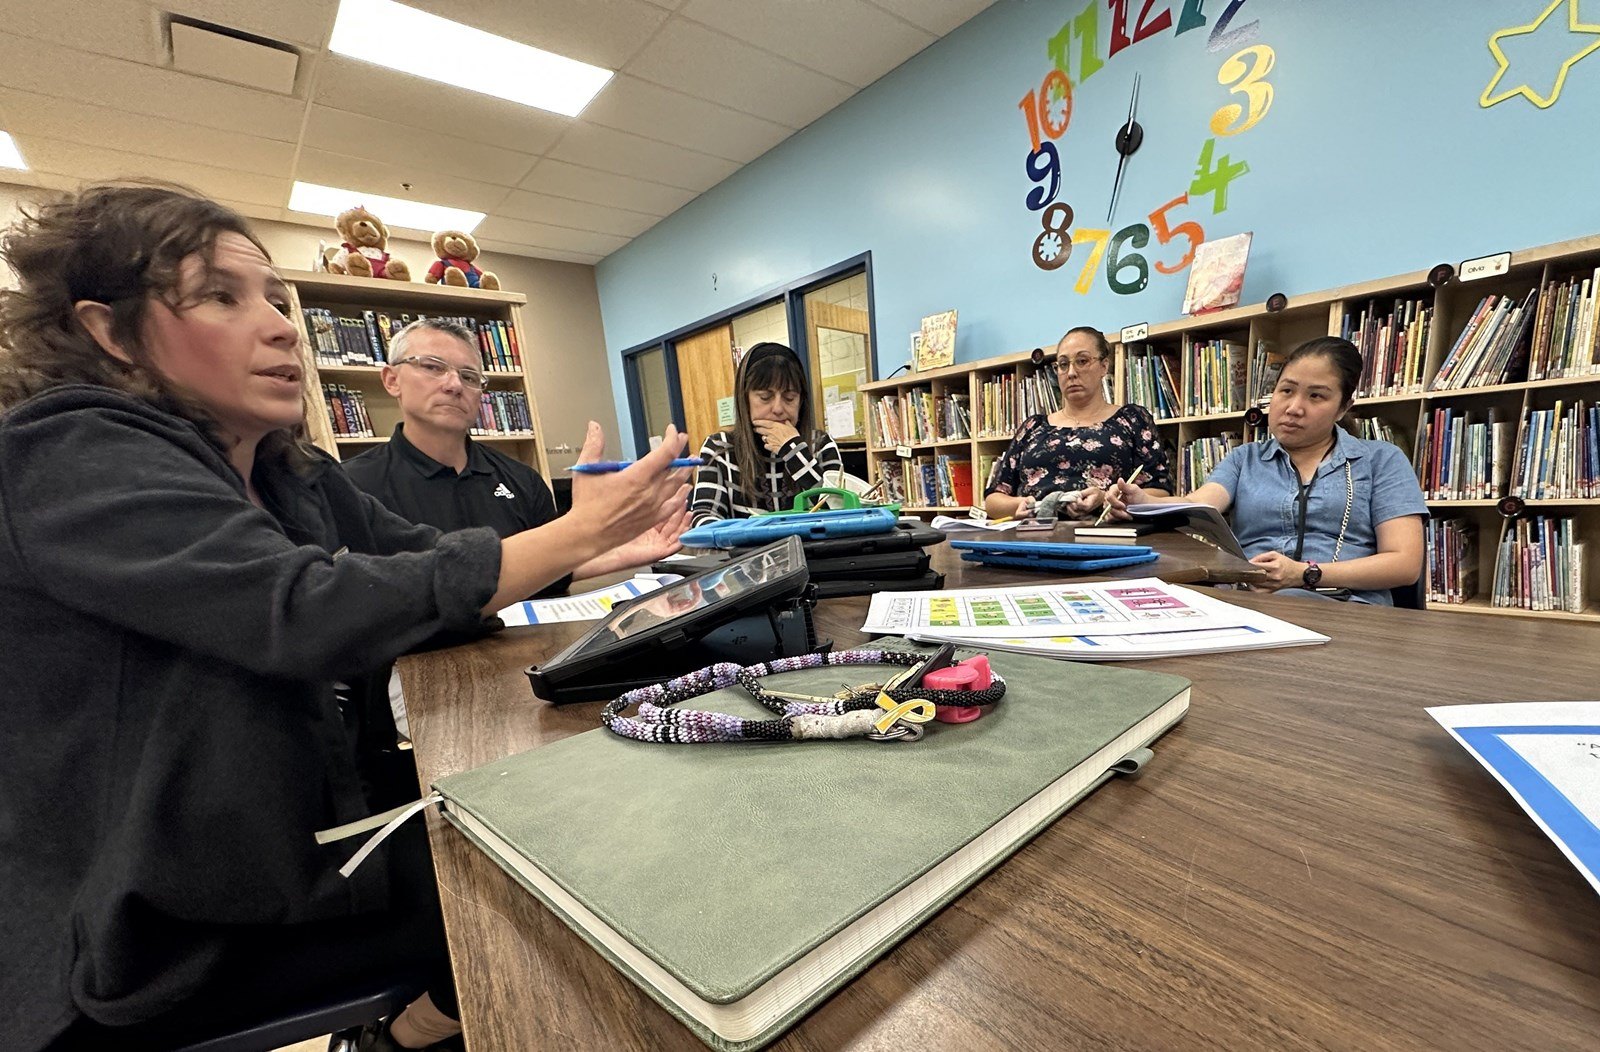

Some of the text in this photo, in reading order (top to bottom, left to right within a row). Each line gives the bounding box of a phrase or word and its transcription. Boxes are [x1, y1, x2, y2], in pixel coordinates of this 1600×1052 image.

[1048, 0, 1104, 103] 11
[1018, 69, 1073, 154] 10
[1209, 44, 1275, 137] 3
[1026, 141, 1061, 211] 9
[1189, 138, 1250, 215] 4
[1032, 202, 1075, 270] 8
[1071, 228, 1111, 295] 7
[1107, 223, 1150, 295] 6
[1148, 191, 1205, 274] 5
[1250, 412, 1258, 421] D
[1505, 502, 1515, 511] G
